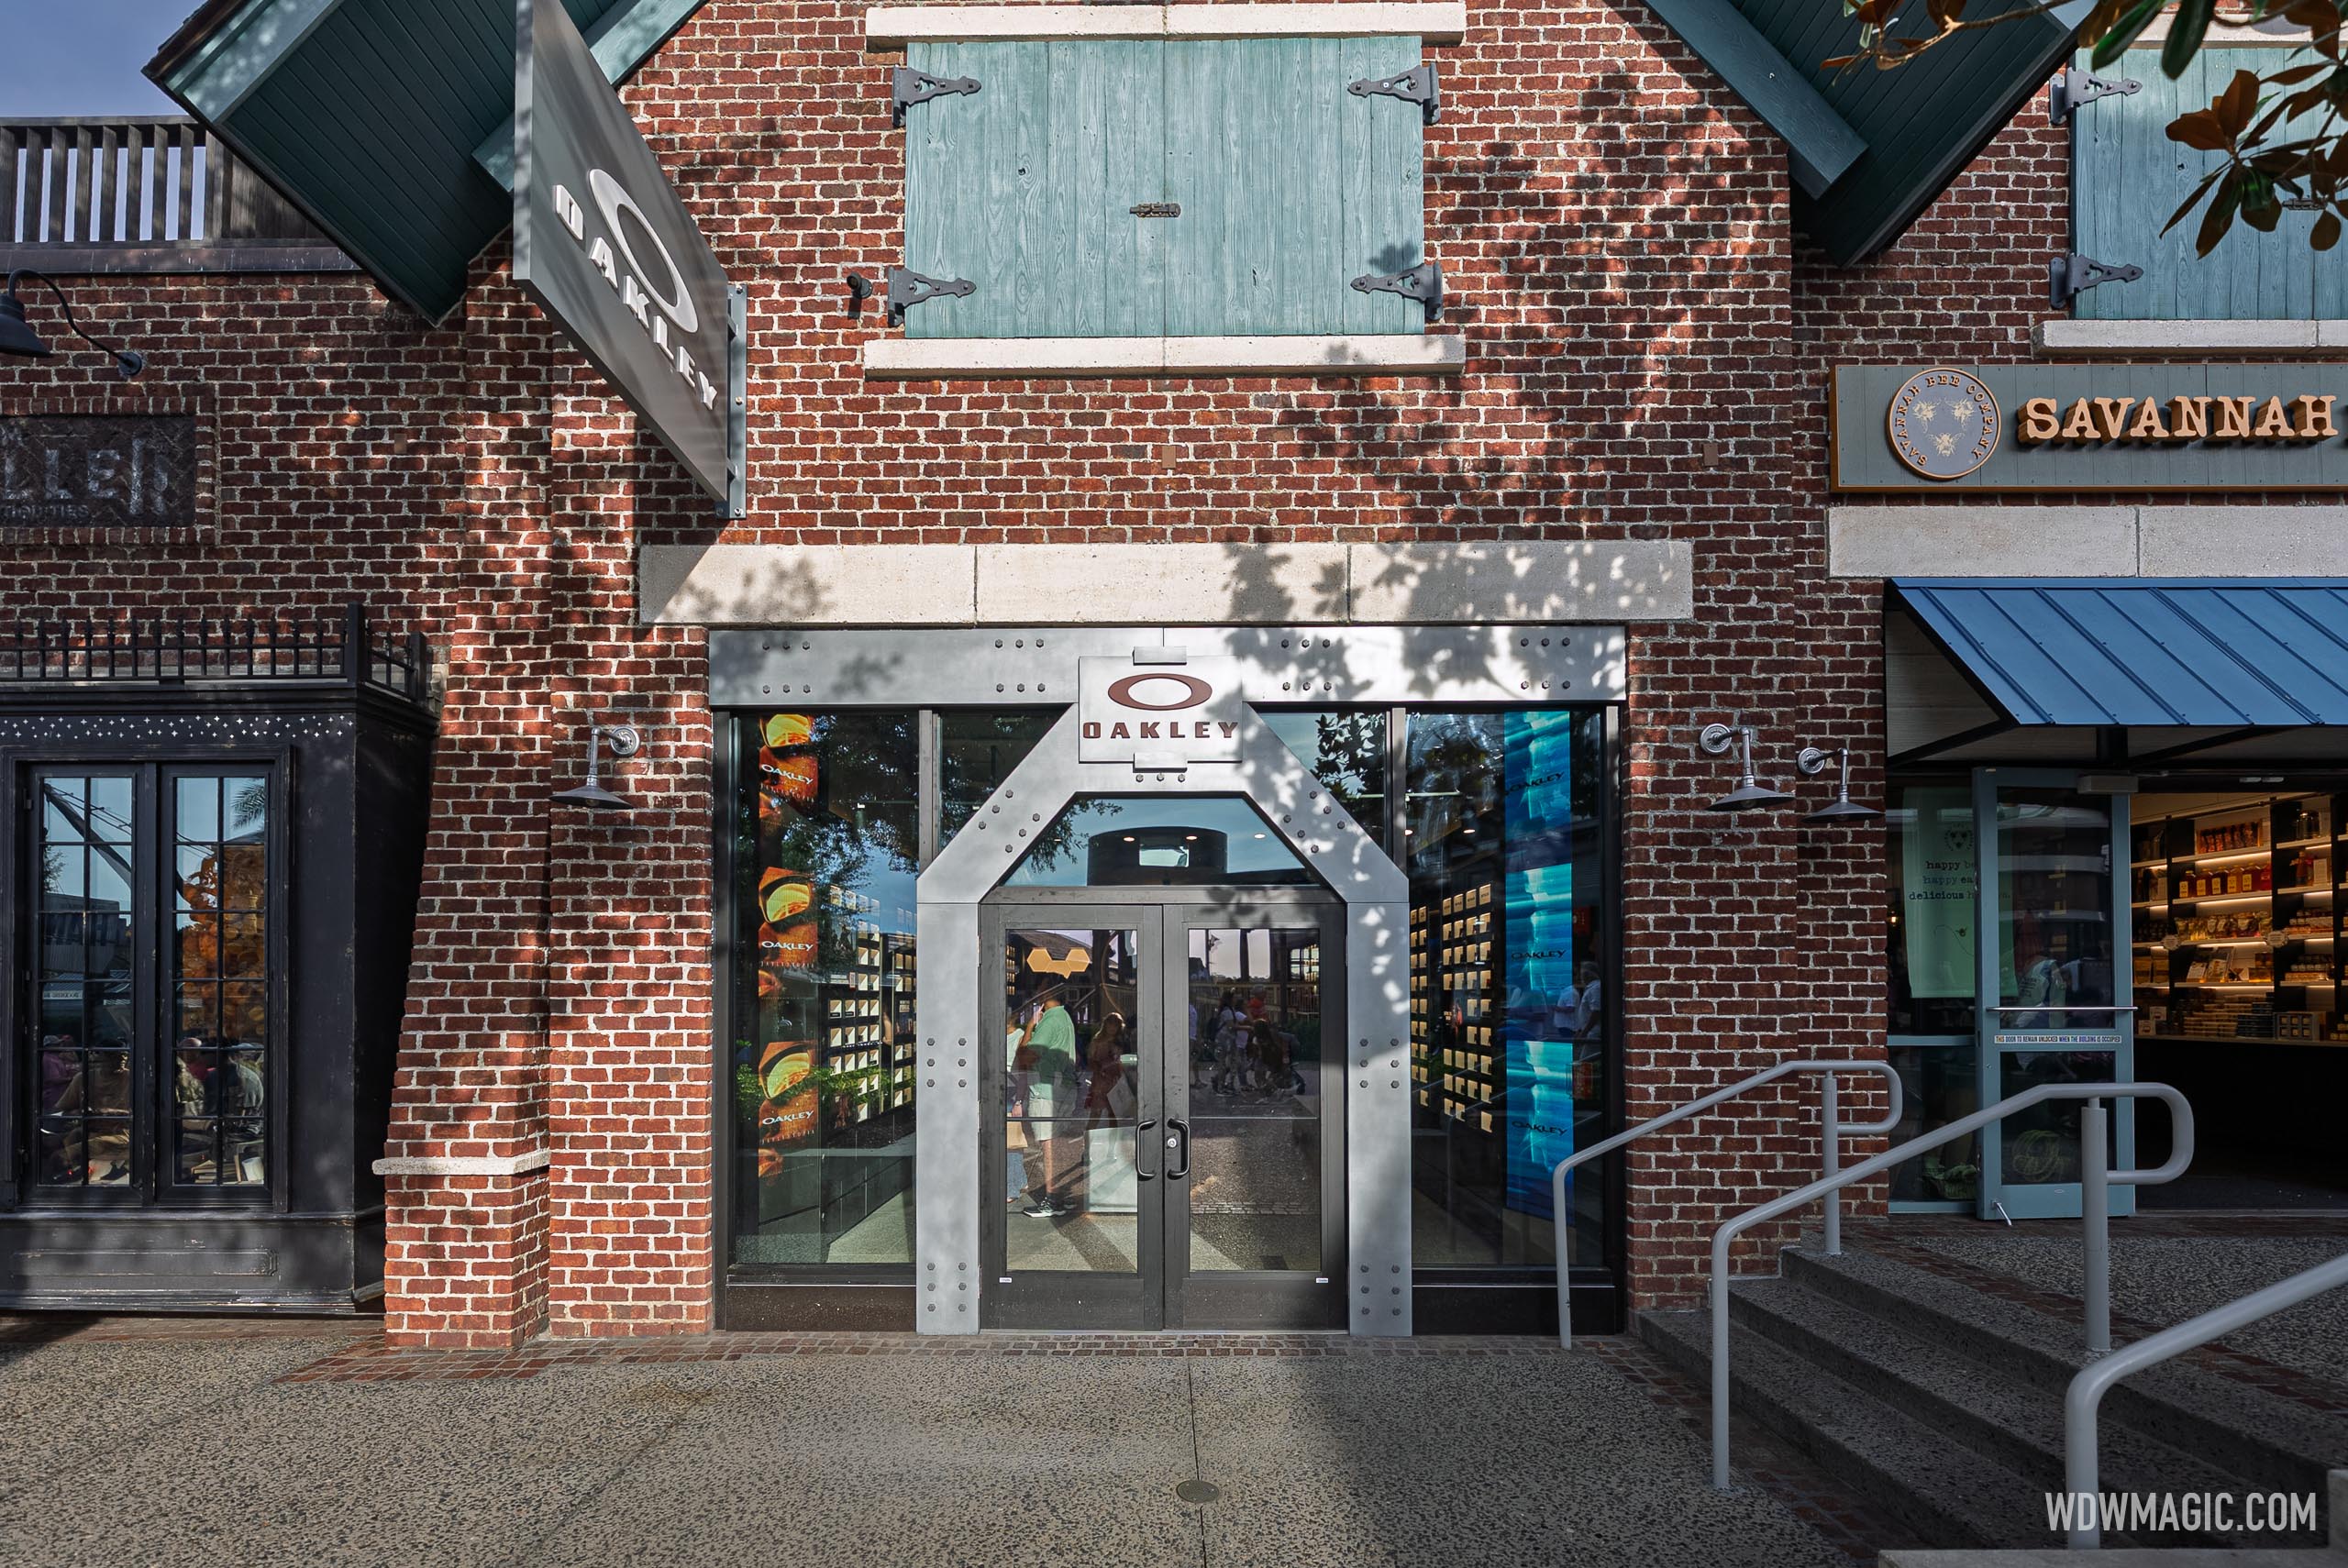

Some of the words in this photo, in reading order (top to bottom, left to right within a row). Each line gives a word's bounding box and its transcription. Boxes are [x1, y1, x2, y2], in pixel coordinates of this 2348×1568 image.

[553, 184, 717, 410] OAKLEY
[1895, 385, 1928, 466] SAVANNAH
[1925, 373, 1961, 387] BEE
[1966, 384, 1995, 459] COMPANY
[2022, 395, 2338, 440] SAVANNAH
[1082, 722, 1239, 739] OAKLEY
[761, 764, 814, 785] OAKLEY
[1511, 771, 1565, 791] OAKLEY
[1926, 861, 1961, 871] happy
[1922, 876, 1957, 886] happy
[1909, 891, 1965, 900] delicious
[761, 941, 814, 952] OAKLEY
[1512, 949, 1567, 959] OAKLEY
[762, 1110, 814, 1125] OAKLEY
[1512, 1121, 1567, 1136] OAKLEY
